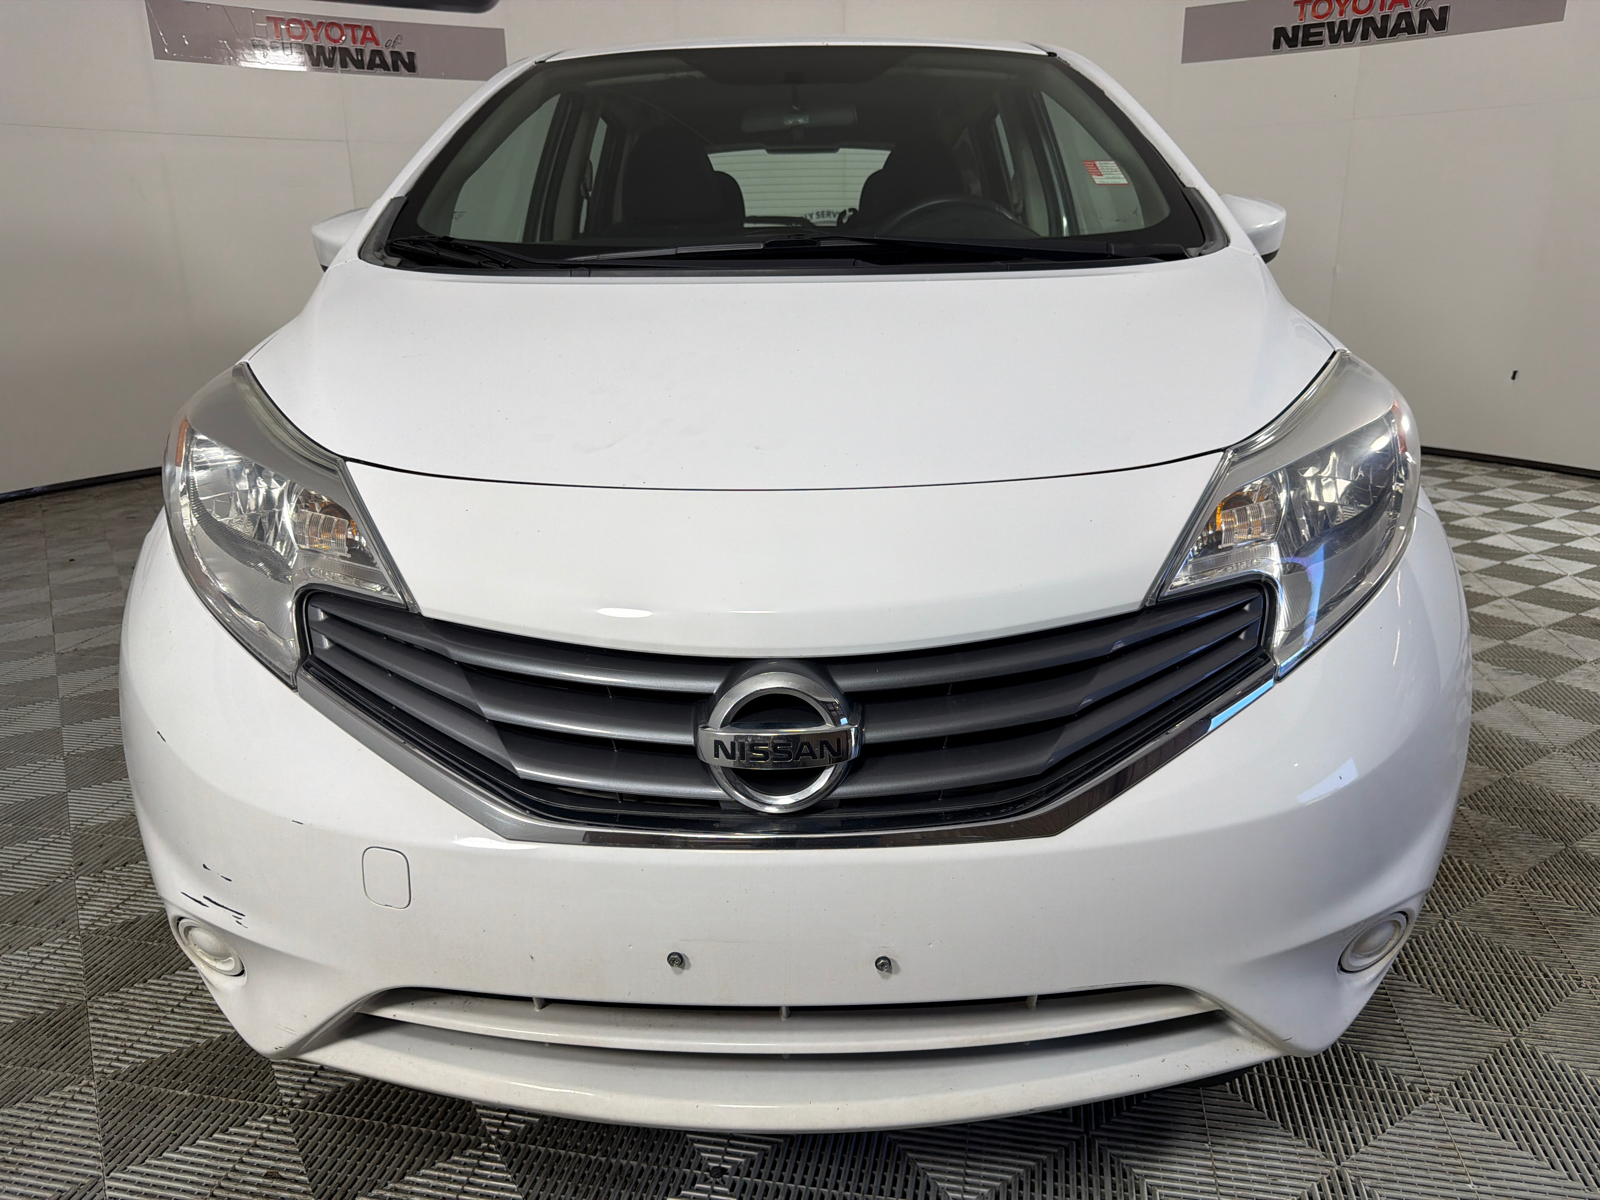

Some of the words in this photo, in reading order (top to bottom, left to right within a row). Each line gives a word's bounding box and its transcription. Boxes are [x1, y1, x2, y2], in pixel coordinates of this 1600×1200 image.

[265, 16, 381, 47] TOYOTA
[385, 34, 402, 49] of
[1272, 6, 1449, 50] NEWNAN
[713, 738, 842, 762] NISSAN
